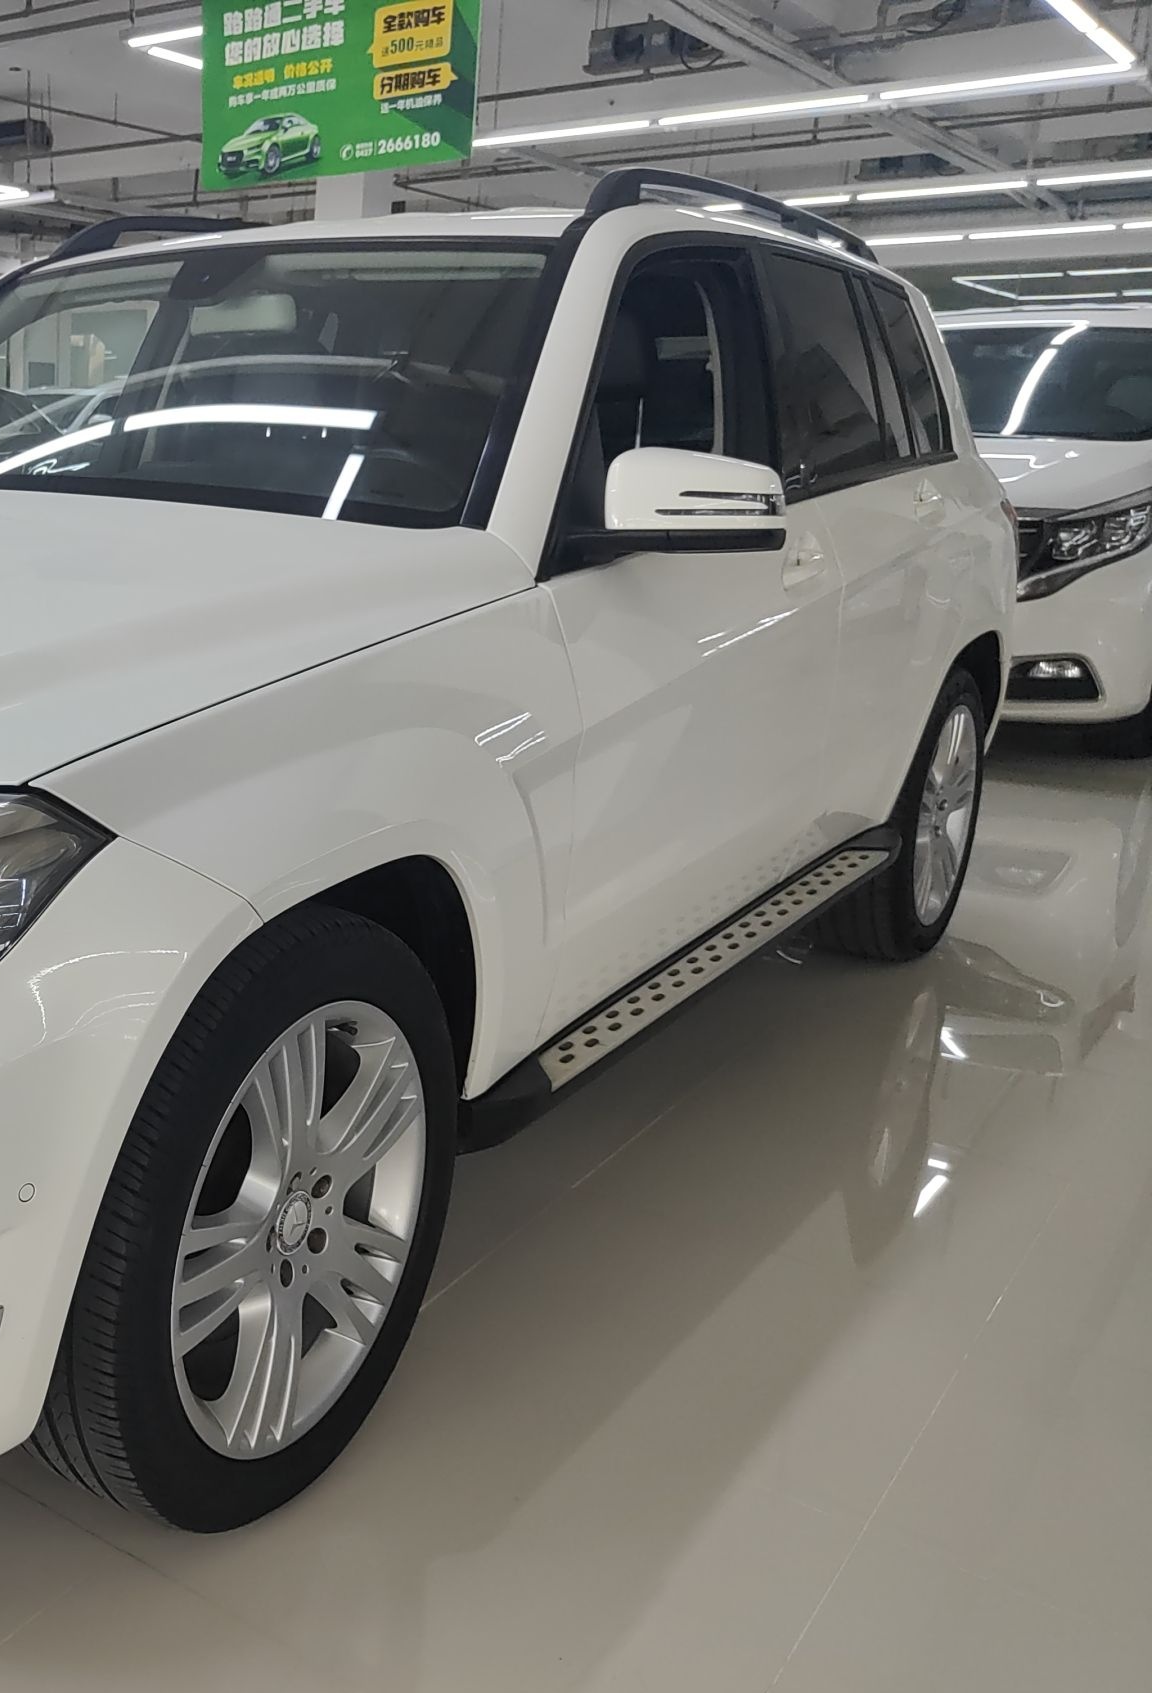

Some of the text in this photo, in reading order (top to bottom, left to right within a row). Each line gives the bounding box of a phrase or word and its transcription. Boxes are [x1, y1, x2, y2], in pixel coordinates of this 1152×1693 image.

[382, 5, 446, 33] 全款购车
[225, 20, 345, 66] 您的放心选择
[284, 58, 333, 80] 价格公开
[380, 67, 442, 95] 分期购车
[378, 131, 441, 155] 2666180
